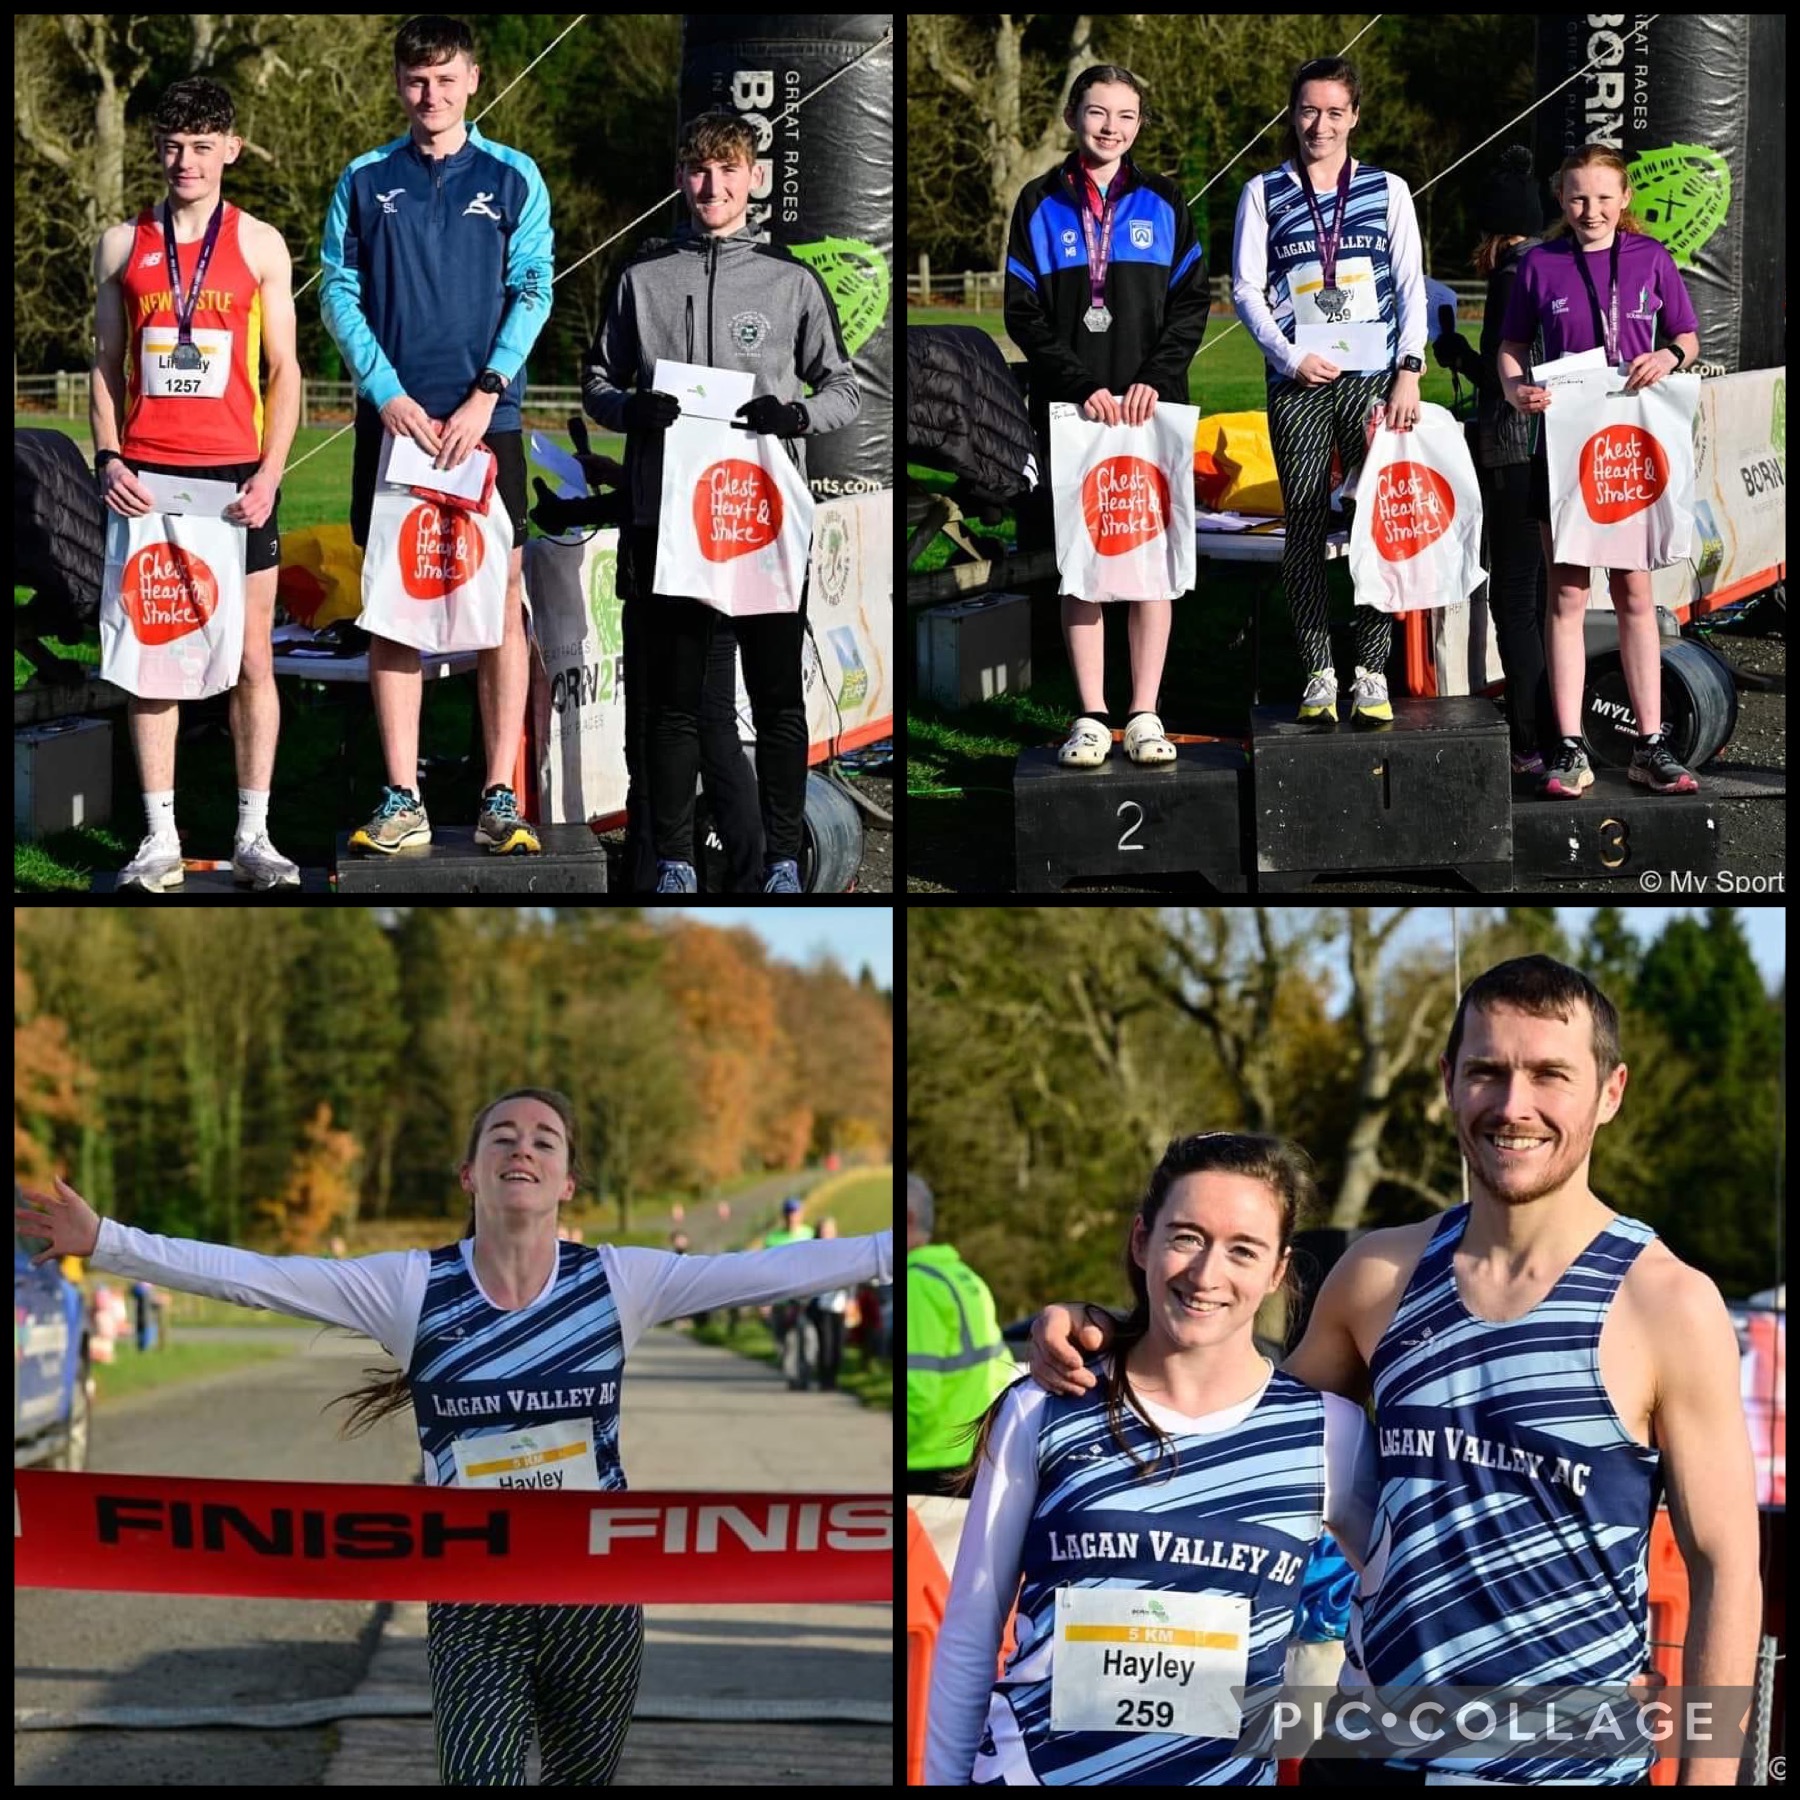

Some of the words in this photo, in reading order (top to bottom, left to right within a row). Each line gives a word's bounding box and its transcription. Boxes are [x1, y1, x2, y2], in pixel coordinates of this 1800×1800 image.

[785, 70, 800, 142] GREAT
[1633, 65, 1649, 130] RACES
[782, 150, 799, 223] RACES
[1274, 240, 1316, 259] LAGAN
[1375, 237, 1388, 253] AC
[139, 289, 235, 318] NEWSTLE
[1326, 308, 1352, 324] 259
[165, 379, 201, 393] 1257
[1594, 433, 1642, 461] Chest
[711, 467, 760, 498] Chest
[1097, 466, 1149, 492] Chest
[1593, 456, 1643, 481] Heart
[1644, 457, 1657, 482] &
[1377, 468, 1423, 500] Chest
[1596, 481, 1654, 505] Stroke
[711, 488, 757, 521] Heart
[756, 499, 771, 525] &
[1099, 486, 1146, 513] Heart
[1378, 494, 1431, 521] Heart
[419, 508, 455, 536] Che
[711, 516, 763, 543] Stroke
[1101, 513, 1157, 537] Stroke
[1385, 517, 1441, 544] Stroke
[140, 574, 189, 603] Heart
[143, 599, 198, 625] Stroke
[1116, 800, 1150, 851] 2
[1600, 818, 1630, 868] 3
[432, 1393, 501, 1417] LAGAN
[507, 1386, 595, 1412] VALLEY
[598, 1382, 617, 1405] AC
[1444, 1427, 1545, 1479] VALLEY
[1550, 1456, 1592, 1497] AC
[96, 1495, 511, 1559] FINISH
[588, 1501, 893, 1555] FINIS
[1049, 1531, 1139, 1561] LAGAN
[1149, 1530, 1270, 1574] VALLEY
[1268, 1551, 1304, 1586] AC
[1129, 1628, 1140, 1642] 5
[1144, 1629, 1175, 1643] KM
[1103, 1649, 1195, 1687] Hayley
[1115, 1700, 1175, 1728] 259
